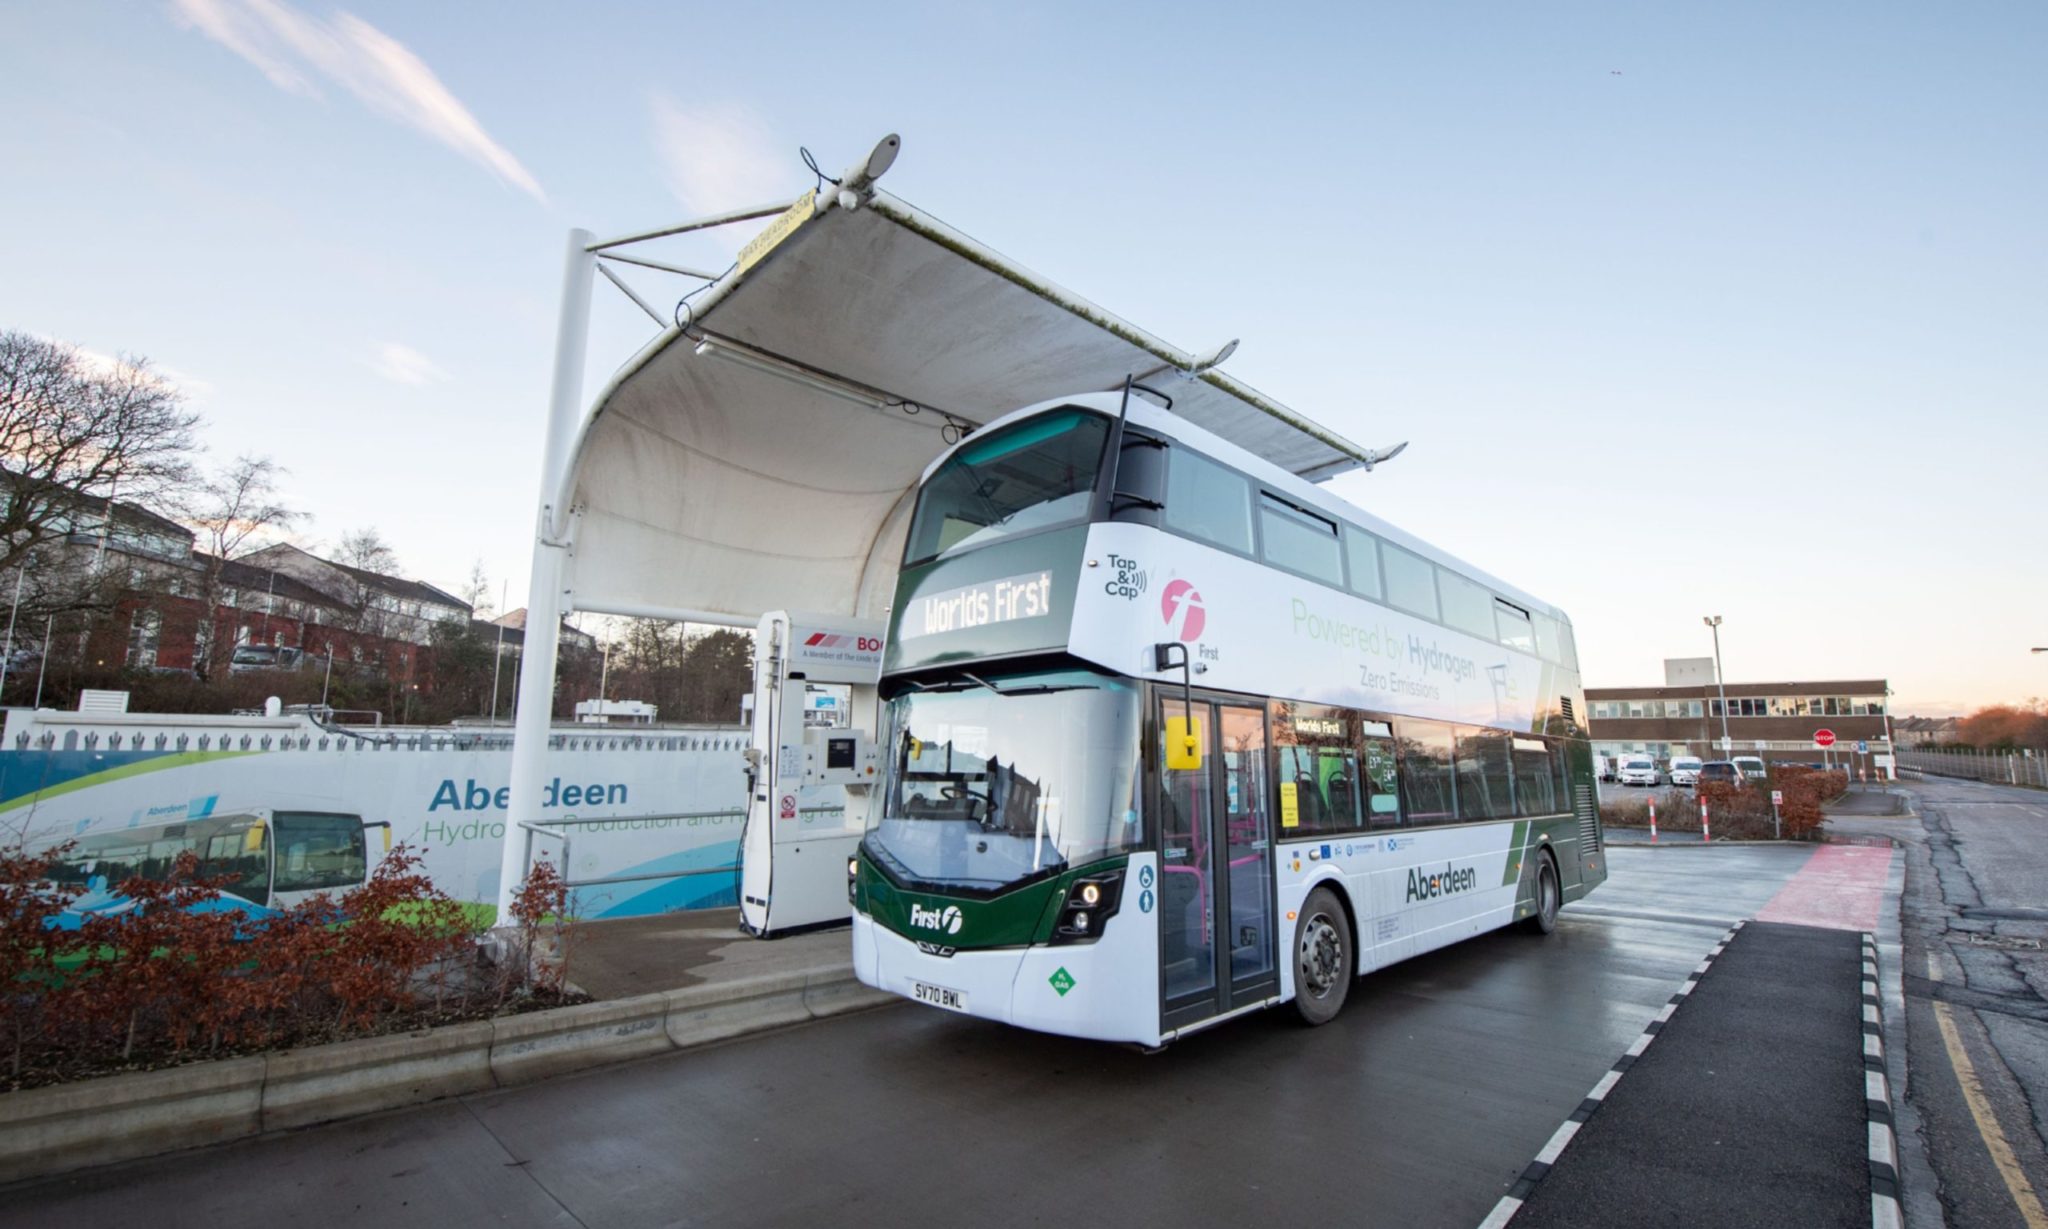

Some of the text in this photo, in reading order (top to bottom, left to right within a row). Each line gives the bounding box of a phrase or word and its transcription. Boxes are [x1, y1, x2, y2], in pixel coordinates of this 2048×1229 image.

[1107, 554, 1137, 572] Tap
[1117, 570, 1129, 584] &
[1105, 581, 1138, 600] Cap
[925, 573, 1049, 634] Worlds First
[858, 637, 884, 651] BO
[1292, 597, 1476, 682] Powered by Hydrogen
[1199, 644, 1219, 660] First
[1360, 664, 1440, 700] Zero Emissions
[1296, 718, 1340, 735] Worlds First
[428, 777, 628, 812] Abedeen
[147, 804, 188, 816] Aberdeen
[424, 817, 552, 846] Hydro
[1406, 861, 1476, 904] Aberdeen
[910, 903, 941, 930] First
[915, 983, 962, 1009] SV70 BWL
[1054, 981, 1069, 989] GAS
